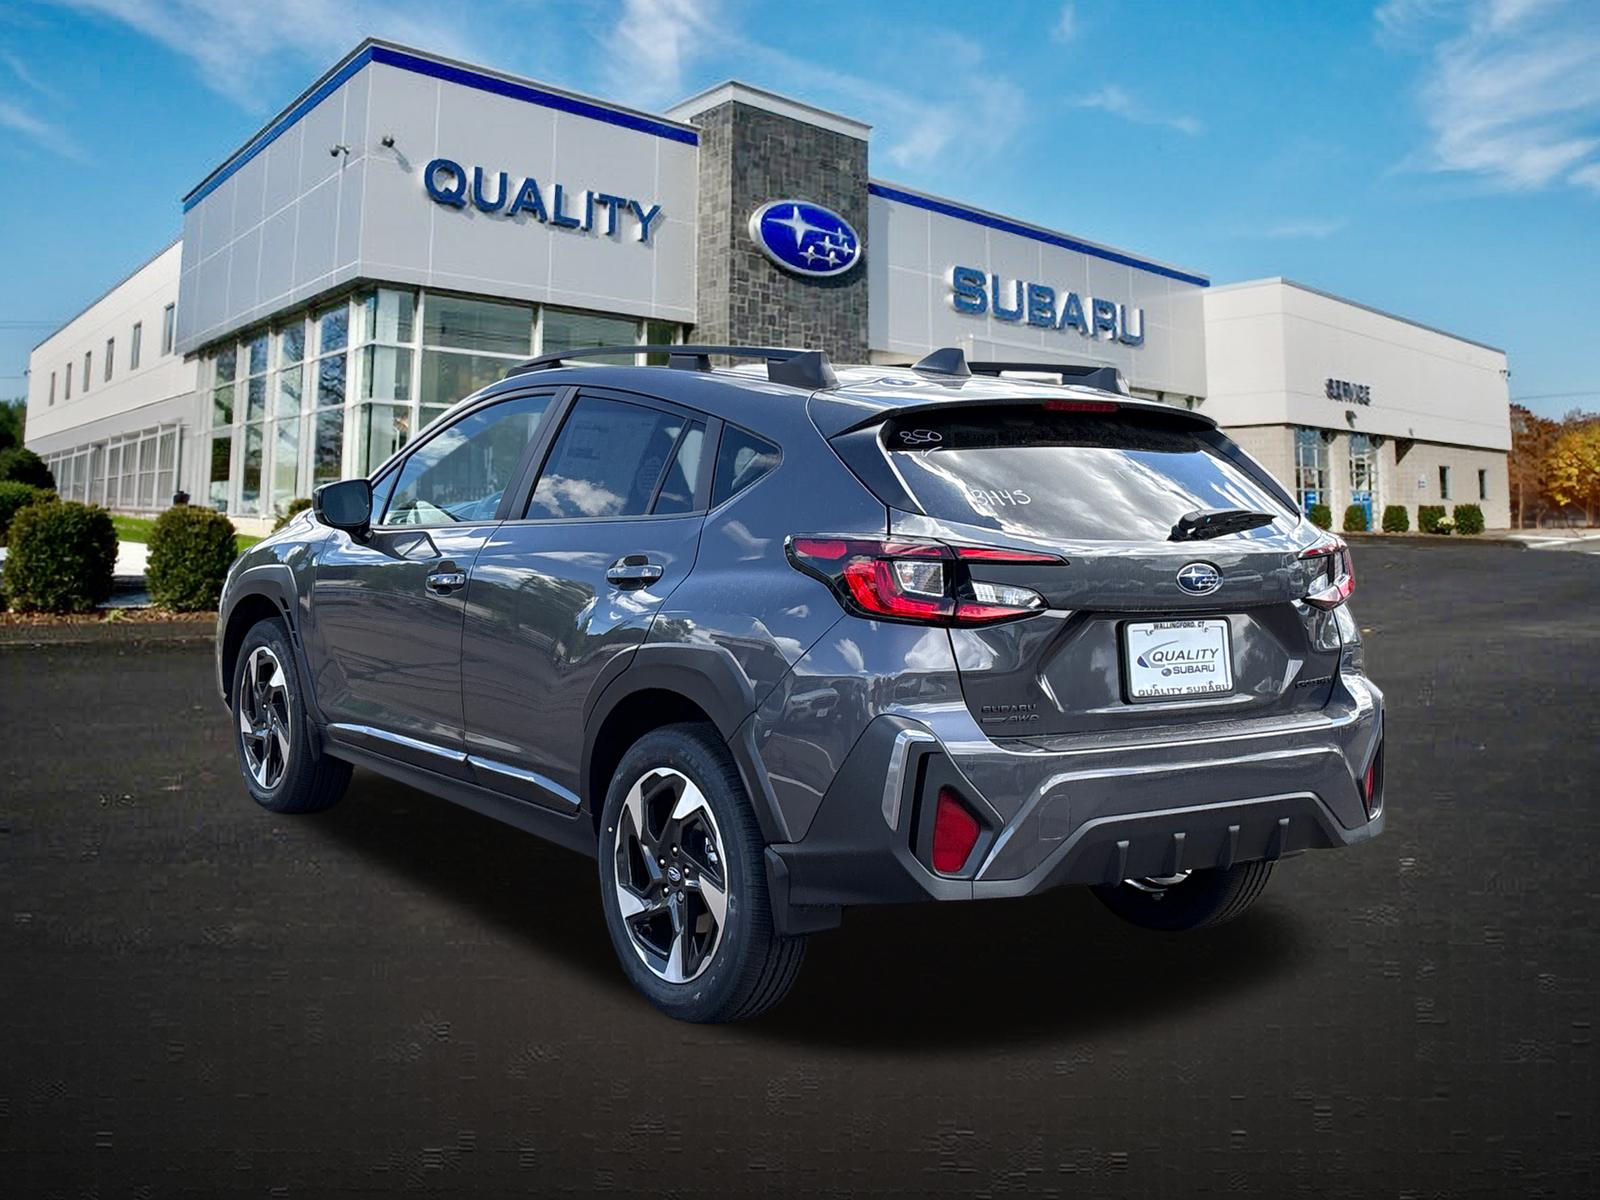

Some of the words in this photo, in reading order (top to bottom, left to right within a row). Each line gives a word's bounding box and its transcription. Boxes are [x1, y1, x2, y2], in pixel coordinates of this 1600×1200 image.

[424, 158, 661, 242] QUALITY
[949, 265, 1145, 346] SUBARU
[1325, 378, 1370, 406] SERVICE
[1152, 648, 1219, 662] QUALITY
[1173, 664, 1215, 674] SUBARU
[1138, 687, 1183, 696] QUALITY
[1187, 684, 1229, 693] SUBARU
[981, 704, 1036, 713] SUBARU
